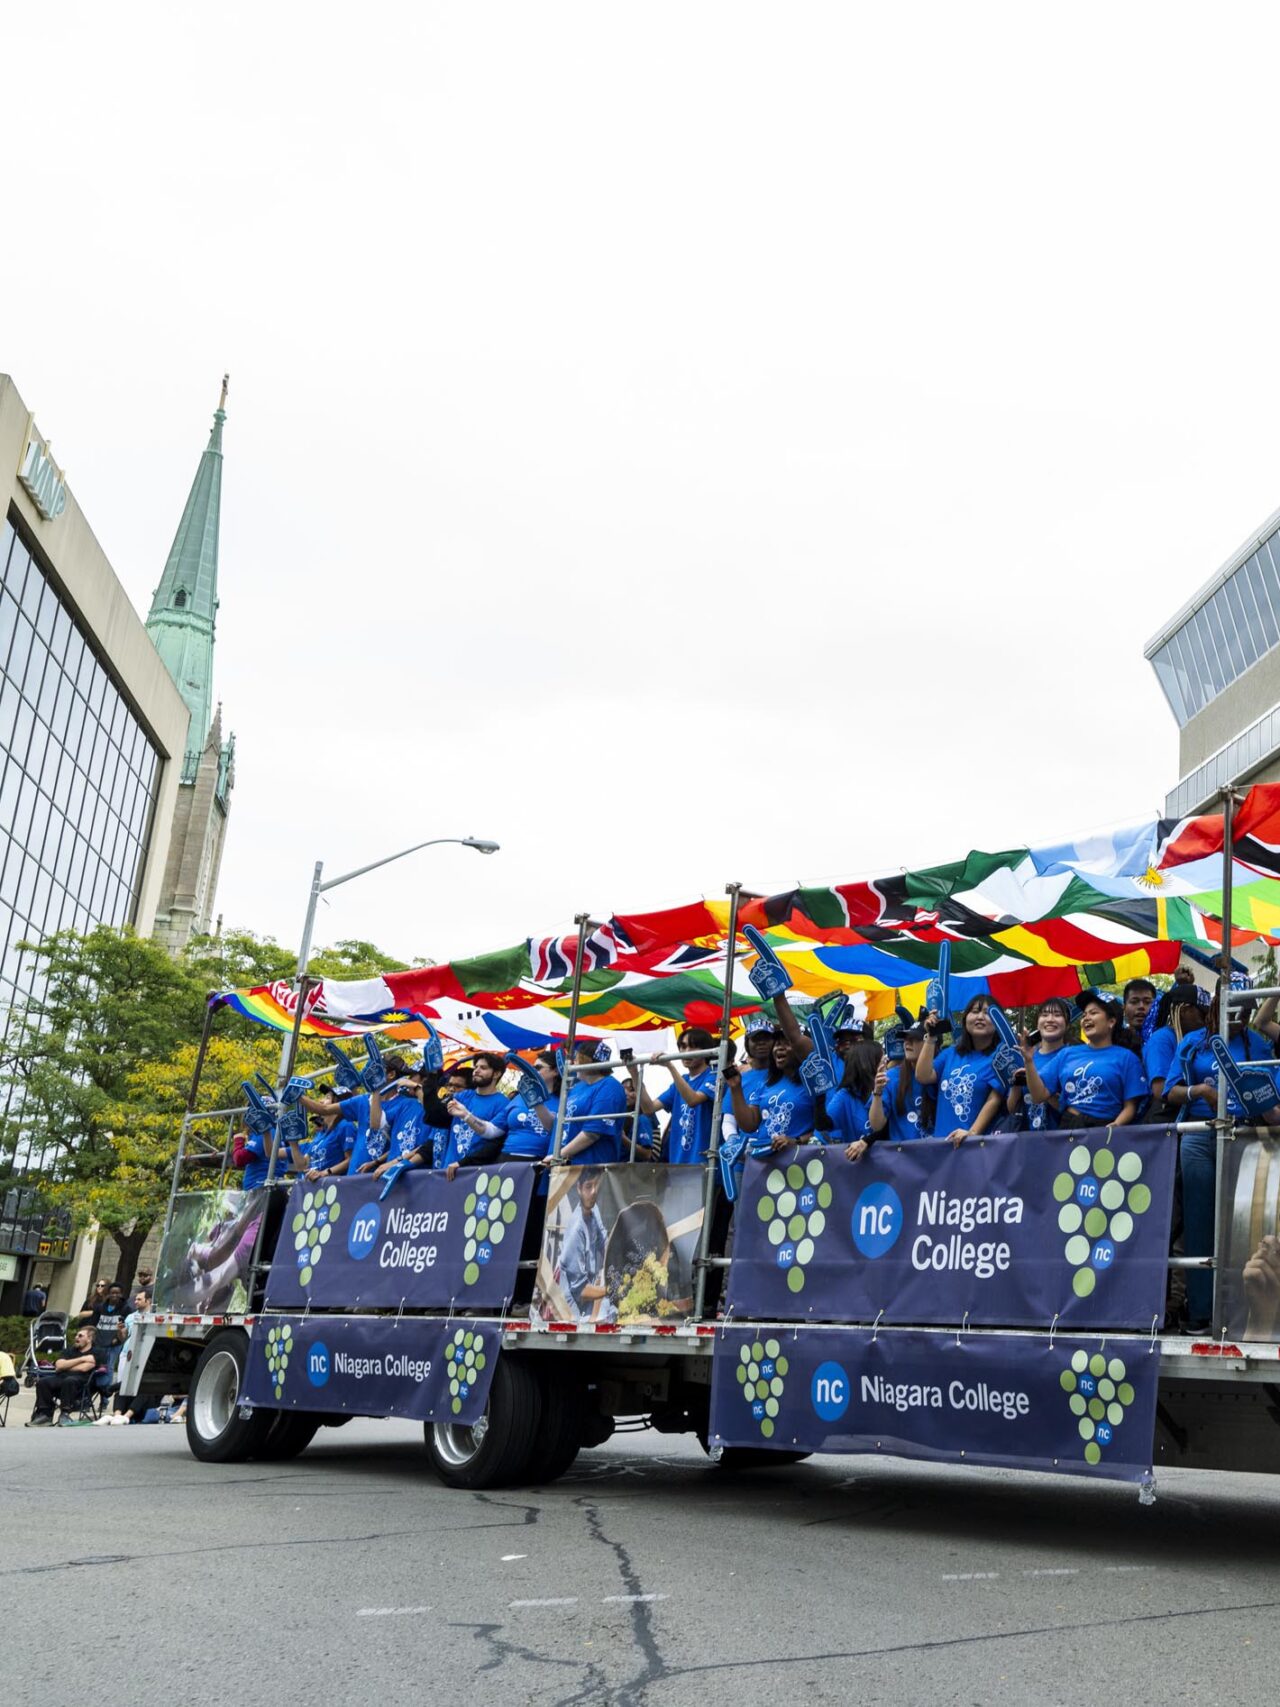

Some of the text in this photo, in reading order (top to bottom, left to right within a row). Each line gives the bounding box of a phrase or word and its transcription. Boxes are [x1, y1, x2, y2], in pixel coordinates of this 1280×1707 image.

[1079, 1181, 1097, 1199] nc
[800, 1191, 814, 1207] nc
[478, 1202, 488, 1212] nc
[860, 1190, 1024, 1235] nc Niagara
[318, 1211, 327, 1221] nc
[352, 1208, 449, 1242] nc Niagara
[298, 1253, 309, 1263] nc
[379, 1240, 437, 1273] College
[478, 1248, 490, 1258] nc
[778, 1247, 793, 1262] nc
[911, 1234, 1010, 1279] College
[1094, 1246, 1112, 1264] nc
[310, 1352, 431, 1383] nc Niagara College
[762, 1364, 773, 1374] nc
[1081, 1381, 1093, 1391] nc
[817, 1376, 1030, 1419] nc Niagara College
[753, 1405, 763, 1415] nc
[1098, 1428, 1110, 1440] nc
